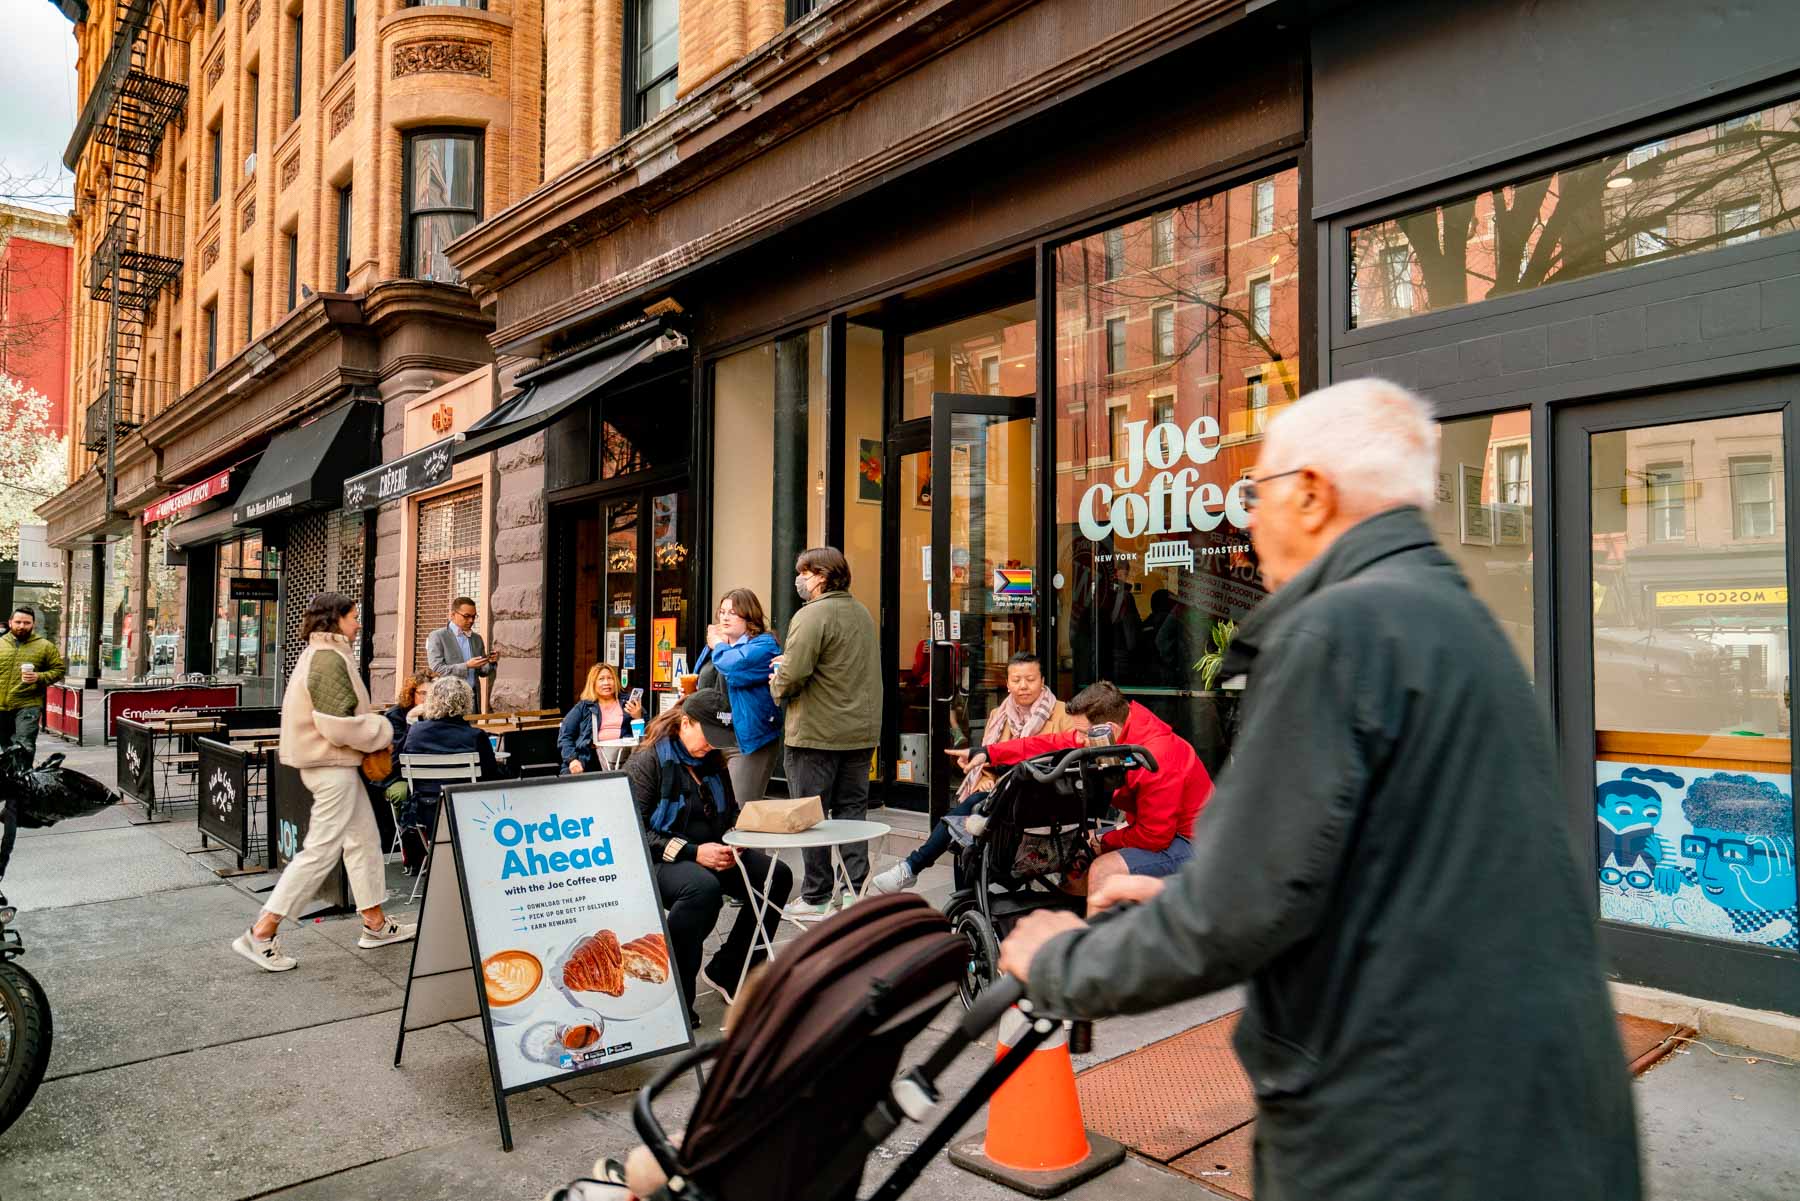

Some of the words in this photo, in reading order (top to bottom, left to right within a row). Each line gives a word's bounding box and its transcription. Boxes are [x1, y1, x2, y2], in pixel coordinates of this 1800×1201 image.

[1114, 416, 1221, 488] Joe
[1095, 554, 1112, 562] NEW
[1115, 553, 1137, 561] YORK
[1202, 545, 1250, 555] ROASTERS
[675, 658, 685, 678] A
[493, 813, 595, 847] Order
[501, 837, 614, 880] Ahead
[504, 886, 526, 896] with
[529, 884, 545, 893] the
[547, 880, 565, 890] Joe
[566, 876, 597, 887] Coffee
[598, 873, 617, 883] app
[527, 900, 561, 910] DOWNLOAD
[529, 913, 545, 921] PICK
[587, 900, 619, 911] DELIVERED
[530, 923, 547, 931] EARN
[548, 918, 577, 928] REWARDS
